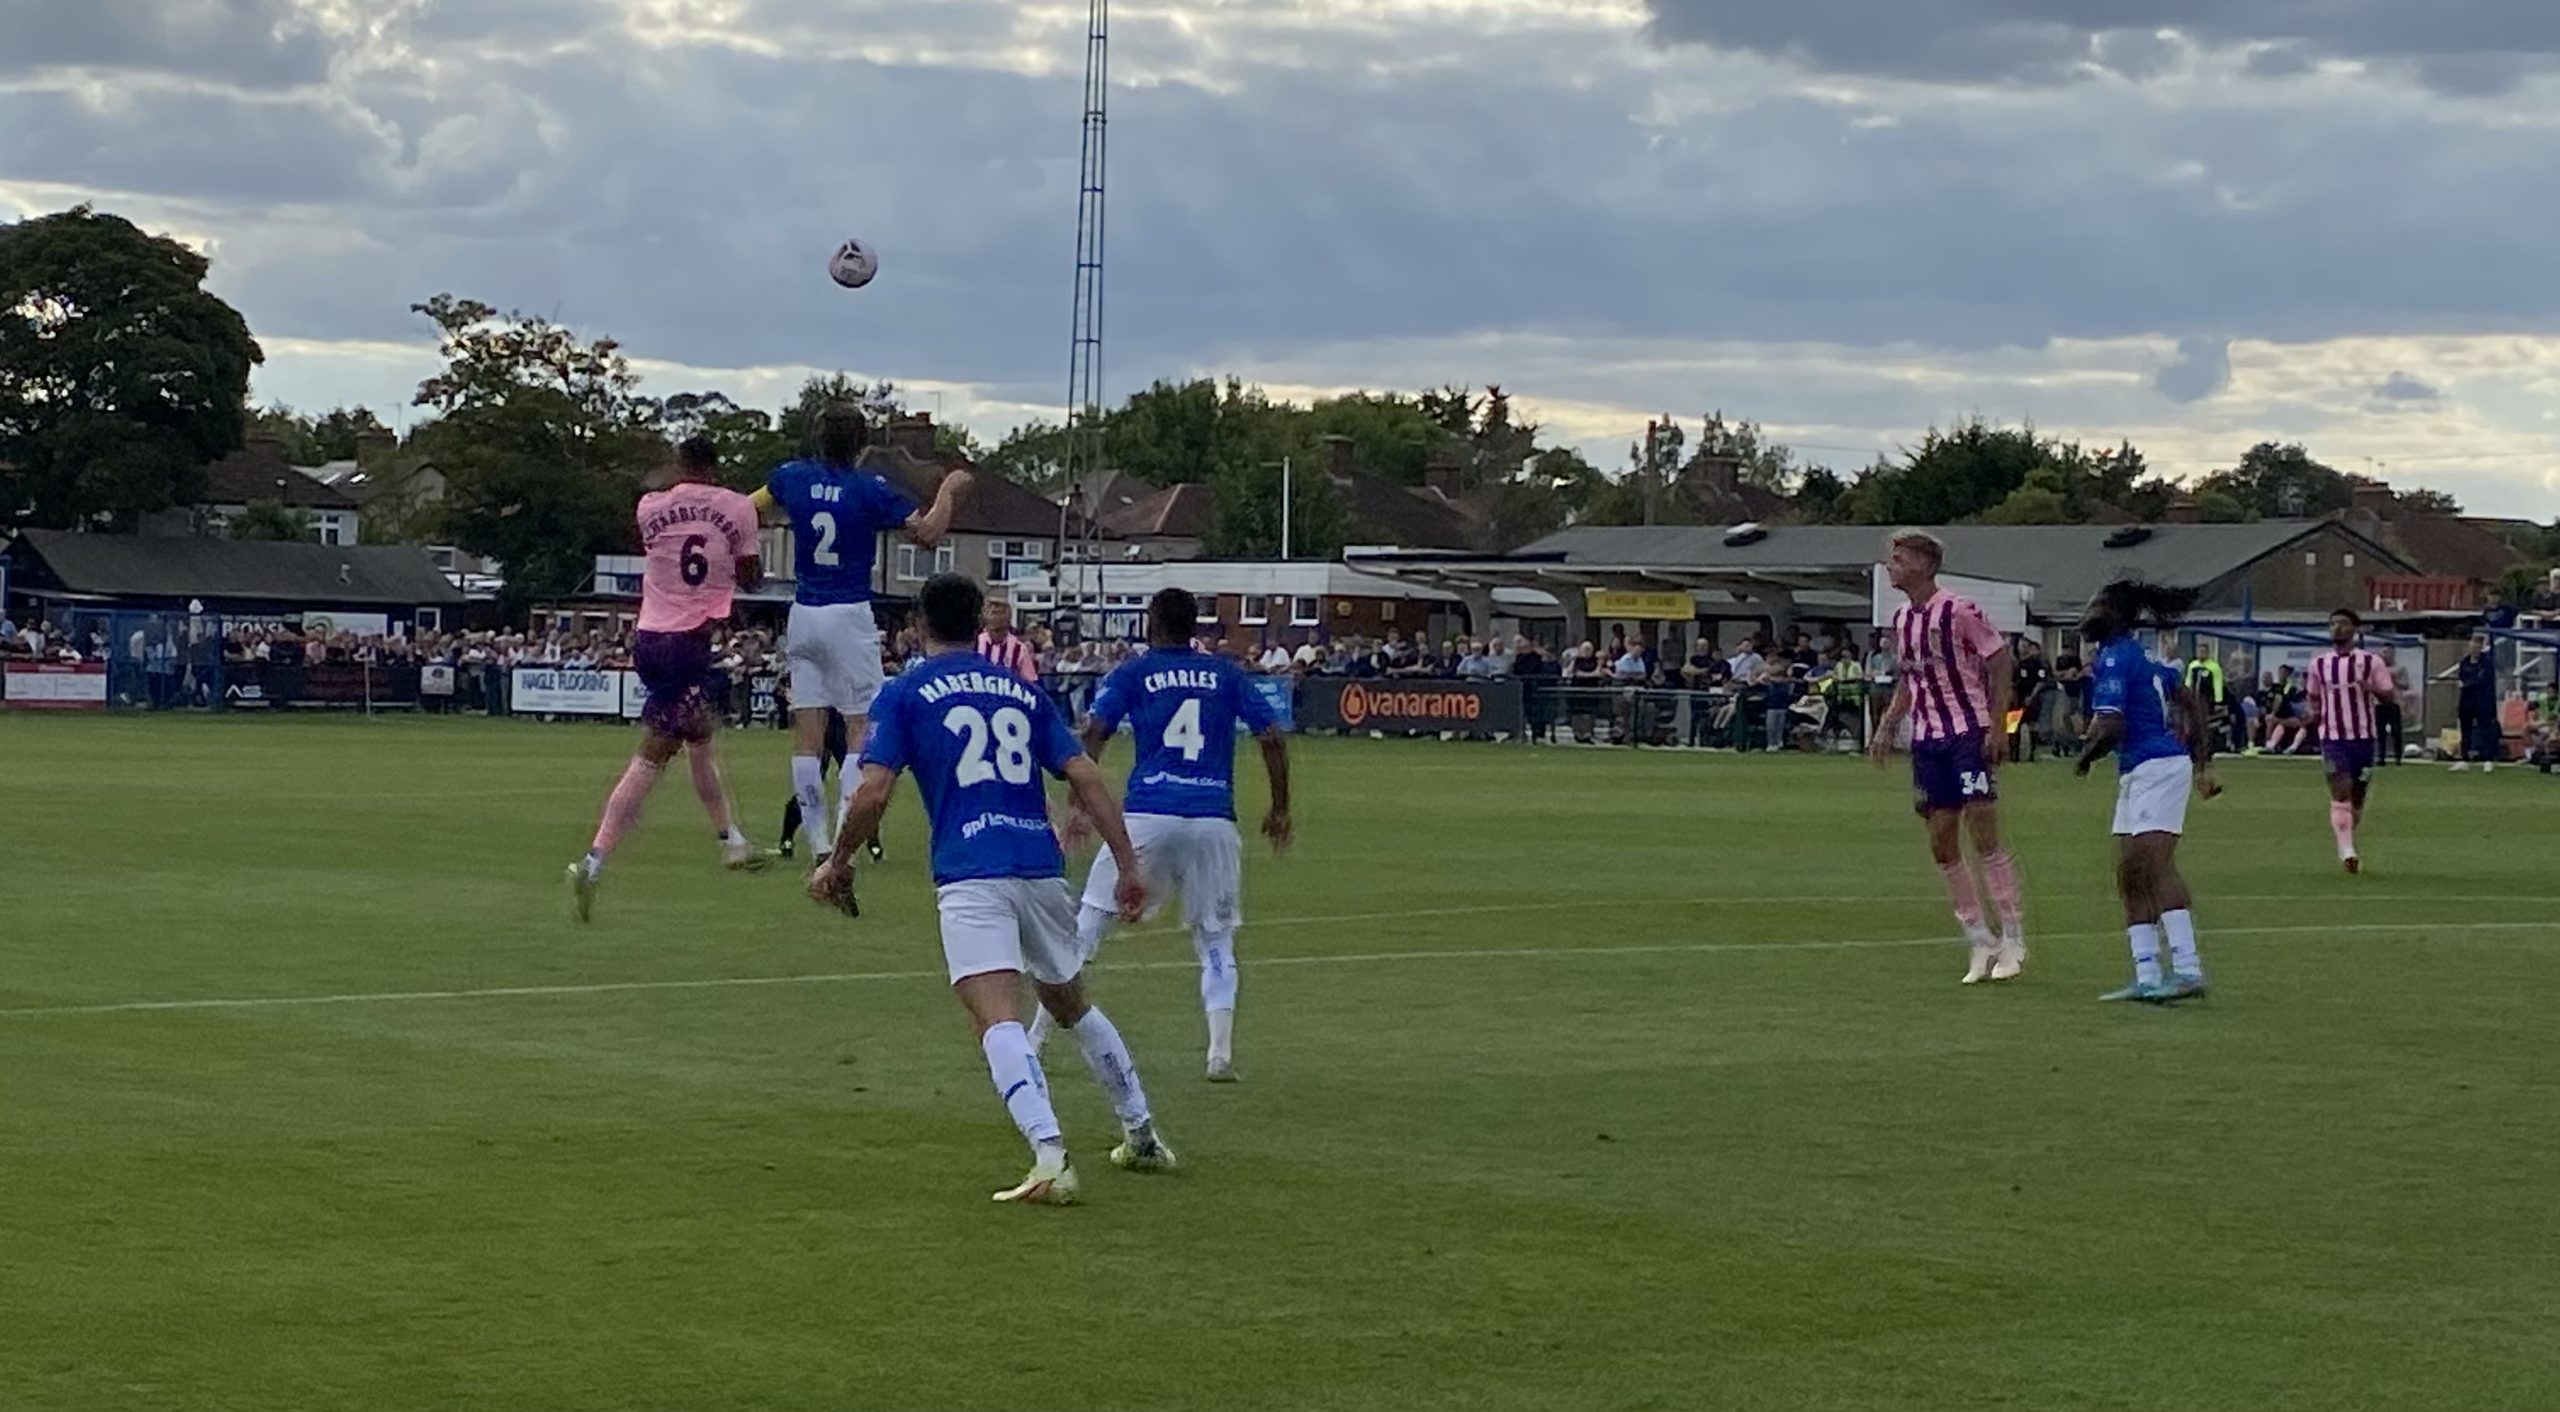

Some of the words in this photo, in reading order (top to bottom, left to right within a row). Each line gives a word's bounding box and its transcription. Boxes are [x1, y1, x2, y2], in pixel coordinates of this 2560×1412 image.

[680, 534, 709, 587] 6
[810, 511, 840, 566] 2
[917, 671, 1037, 711] HABERGHAM
[1144, 669, 1219, 693] CHARLES
[1367, 692, 1480, 719] vanarama
[942, 704, 1033, 788] 28
[1162, 698, 1206, 762] 4
[1960, 771, 1990, 795] 34
